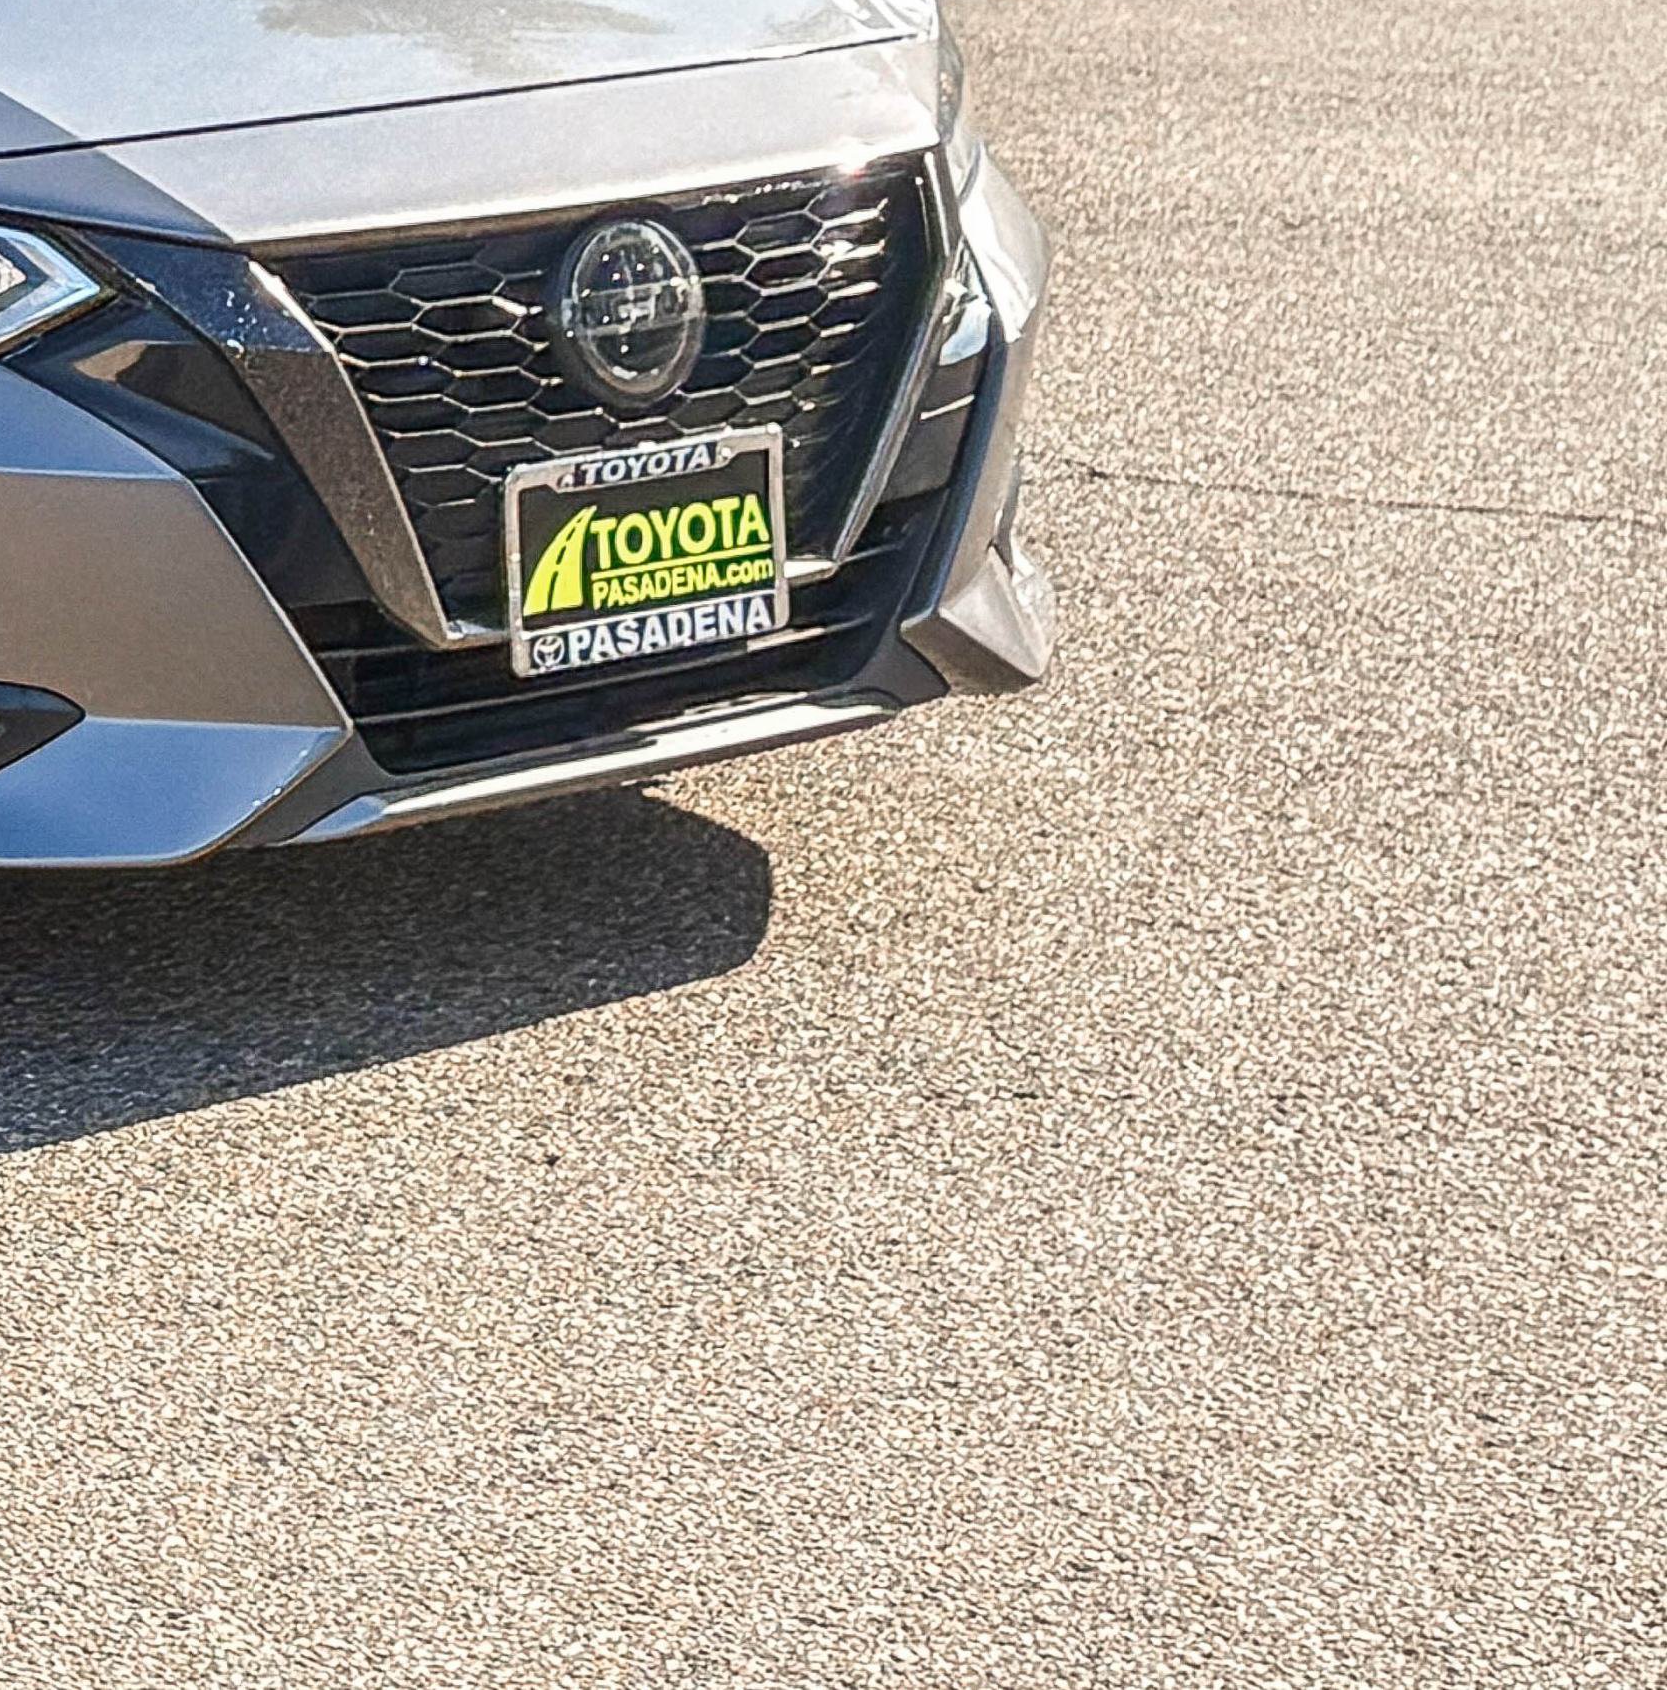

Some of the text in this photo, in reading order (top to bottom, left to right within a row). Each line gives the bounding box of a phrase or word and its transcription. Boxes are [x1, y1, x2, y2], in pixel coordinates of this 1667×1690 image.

[579, 444, 712, 487] TOYOTA
[590, 493, 771, 570] TOYOTA
[592, 557, 774, 610] PASADENA.com
[568, 598, 773, 664] PASADENA
